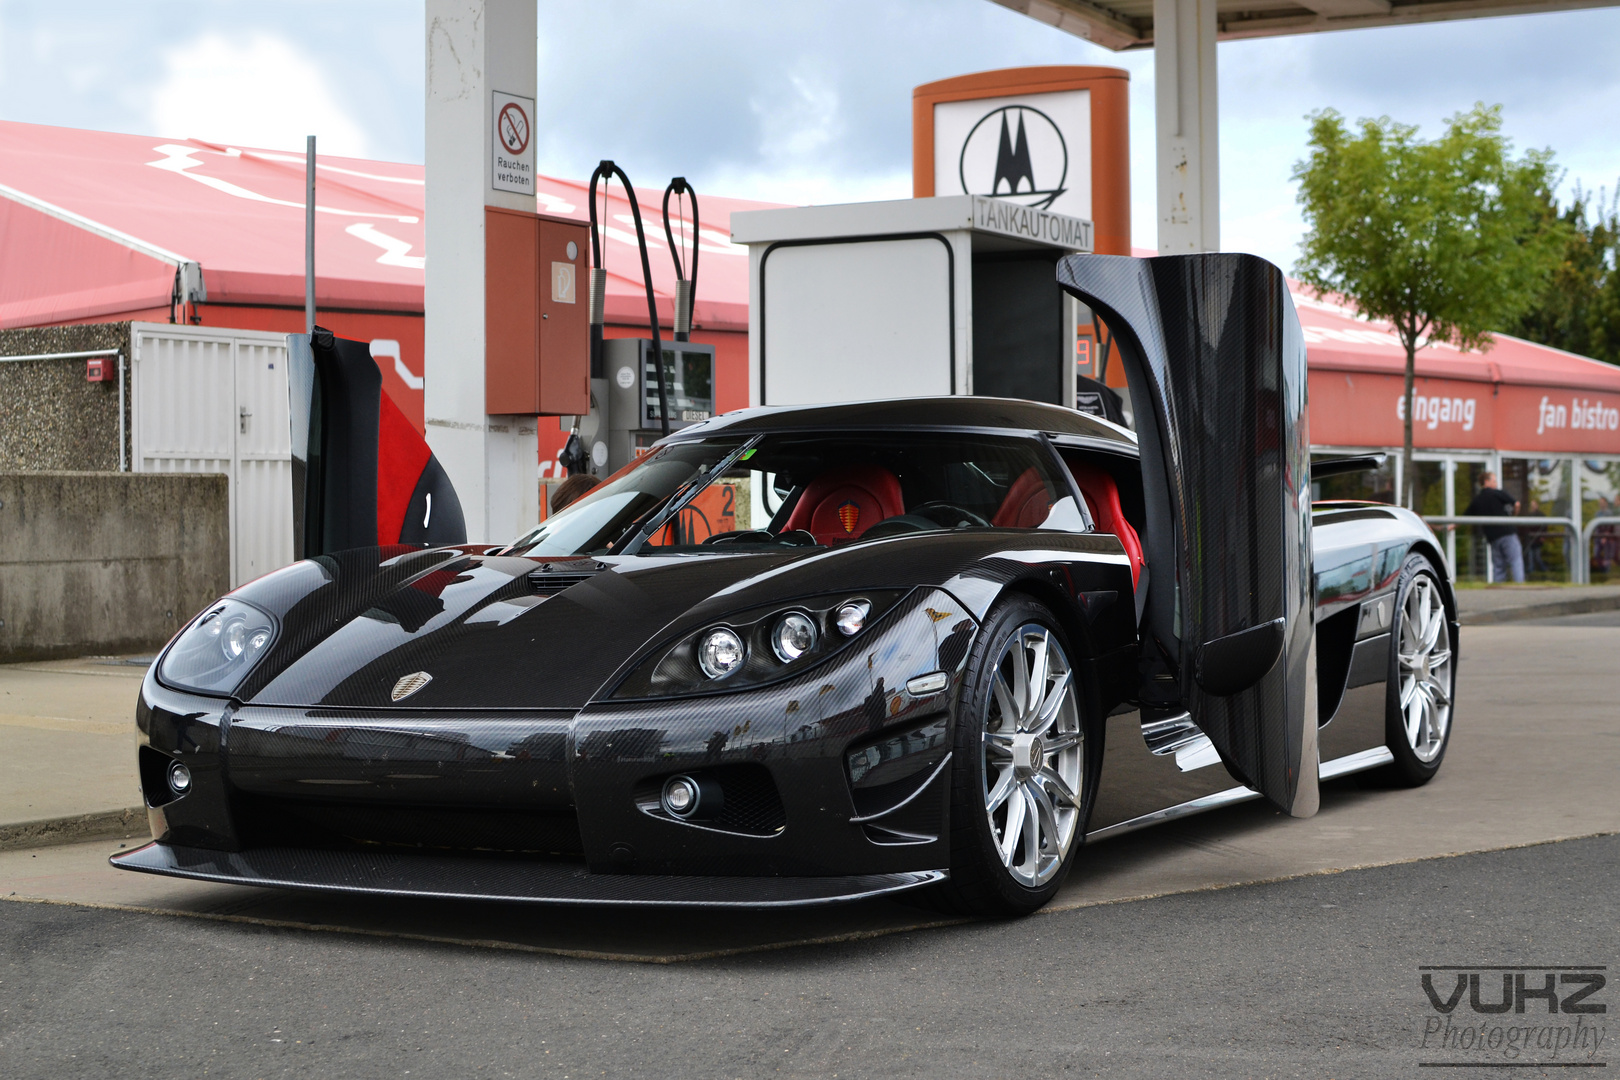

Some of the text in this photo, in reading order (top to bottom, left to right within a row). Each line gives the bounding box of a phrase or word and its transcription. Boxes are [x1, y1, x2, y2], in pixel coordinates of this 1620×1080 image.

[497, 156, 530, 172] Rauchen
[497, 172, 530, 186] verboten
[977, 199, 1091, 248] TANKAUTOMAT
[685, 410, 706, 421] DIESEL
[1396, 387, 1477, 431] eingang
[1537, 395, 1619, 435] fan bistro
[722, 486, 734, 516] 2
